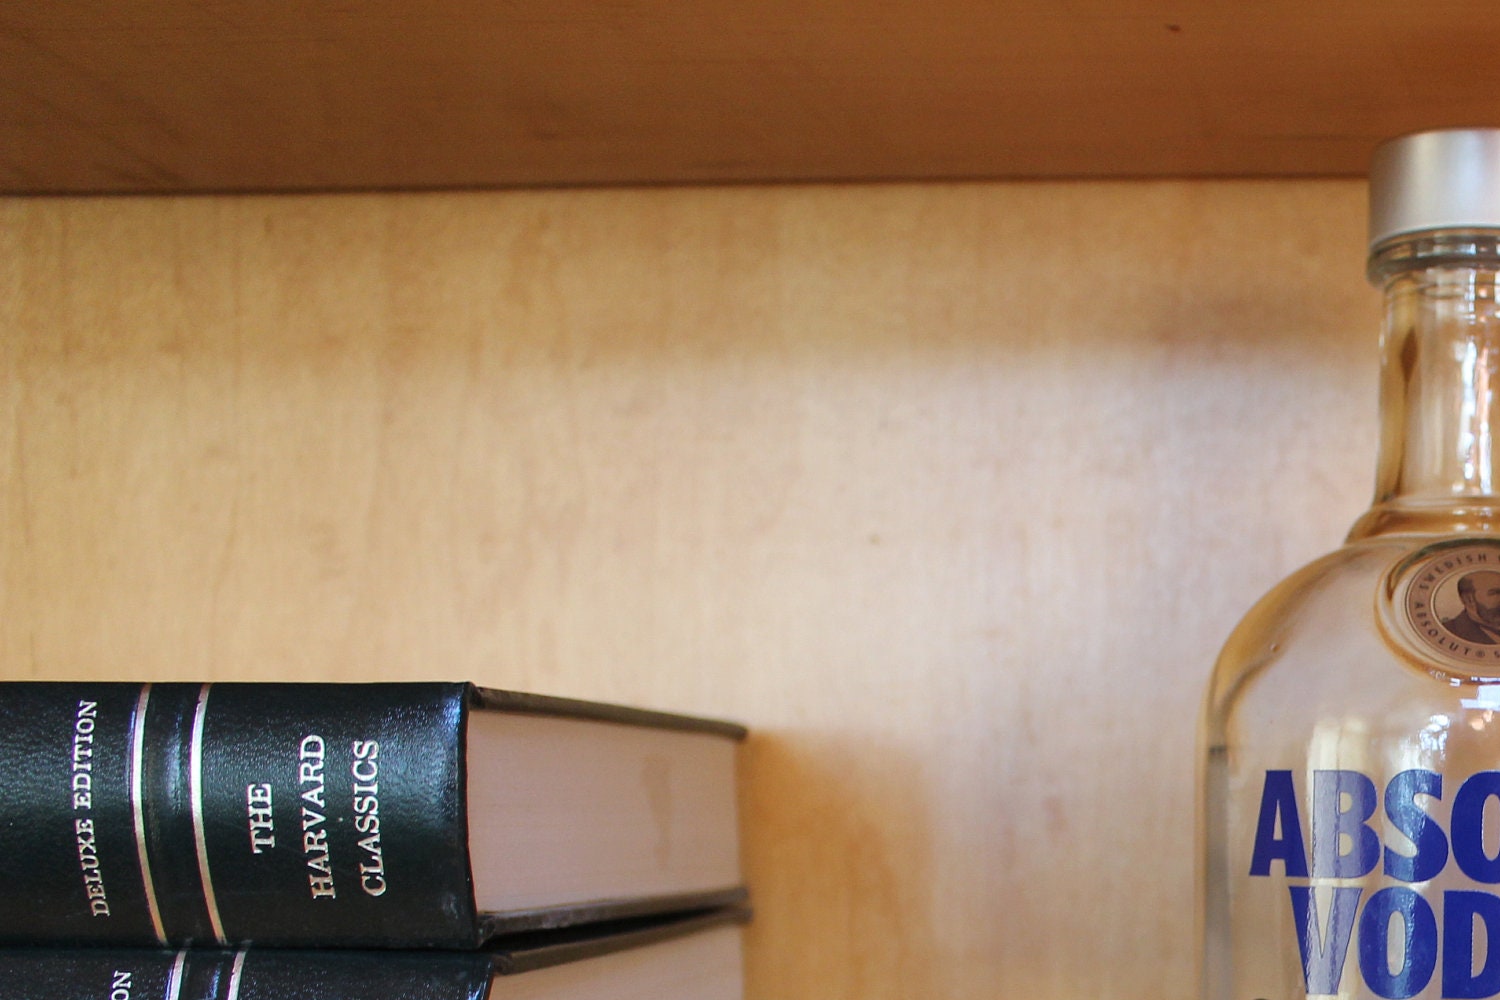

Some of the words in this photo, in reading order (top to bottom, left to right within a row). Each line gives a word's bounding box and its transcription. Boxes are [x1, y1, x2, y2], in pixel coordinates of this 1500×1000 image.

[1419, 553, 1487, 591] SWEDISH
[73, 700, 98, 810] EDITION
[75, 818, 110, 917] DELUXE
[247, 783, 275, 854] THE
[300, 734, 336, 900] HARVARD
[353, 740, 388, 897] CLASSICS
